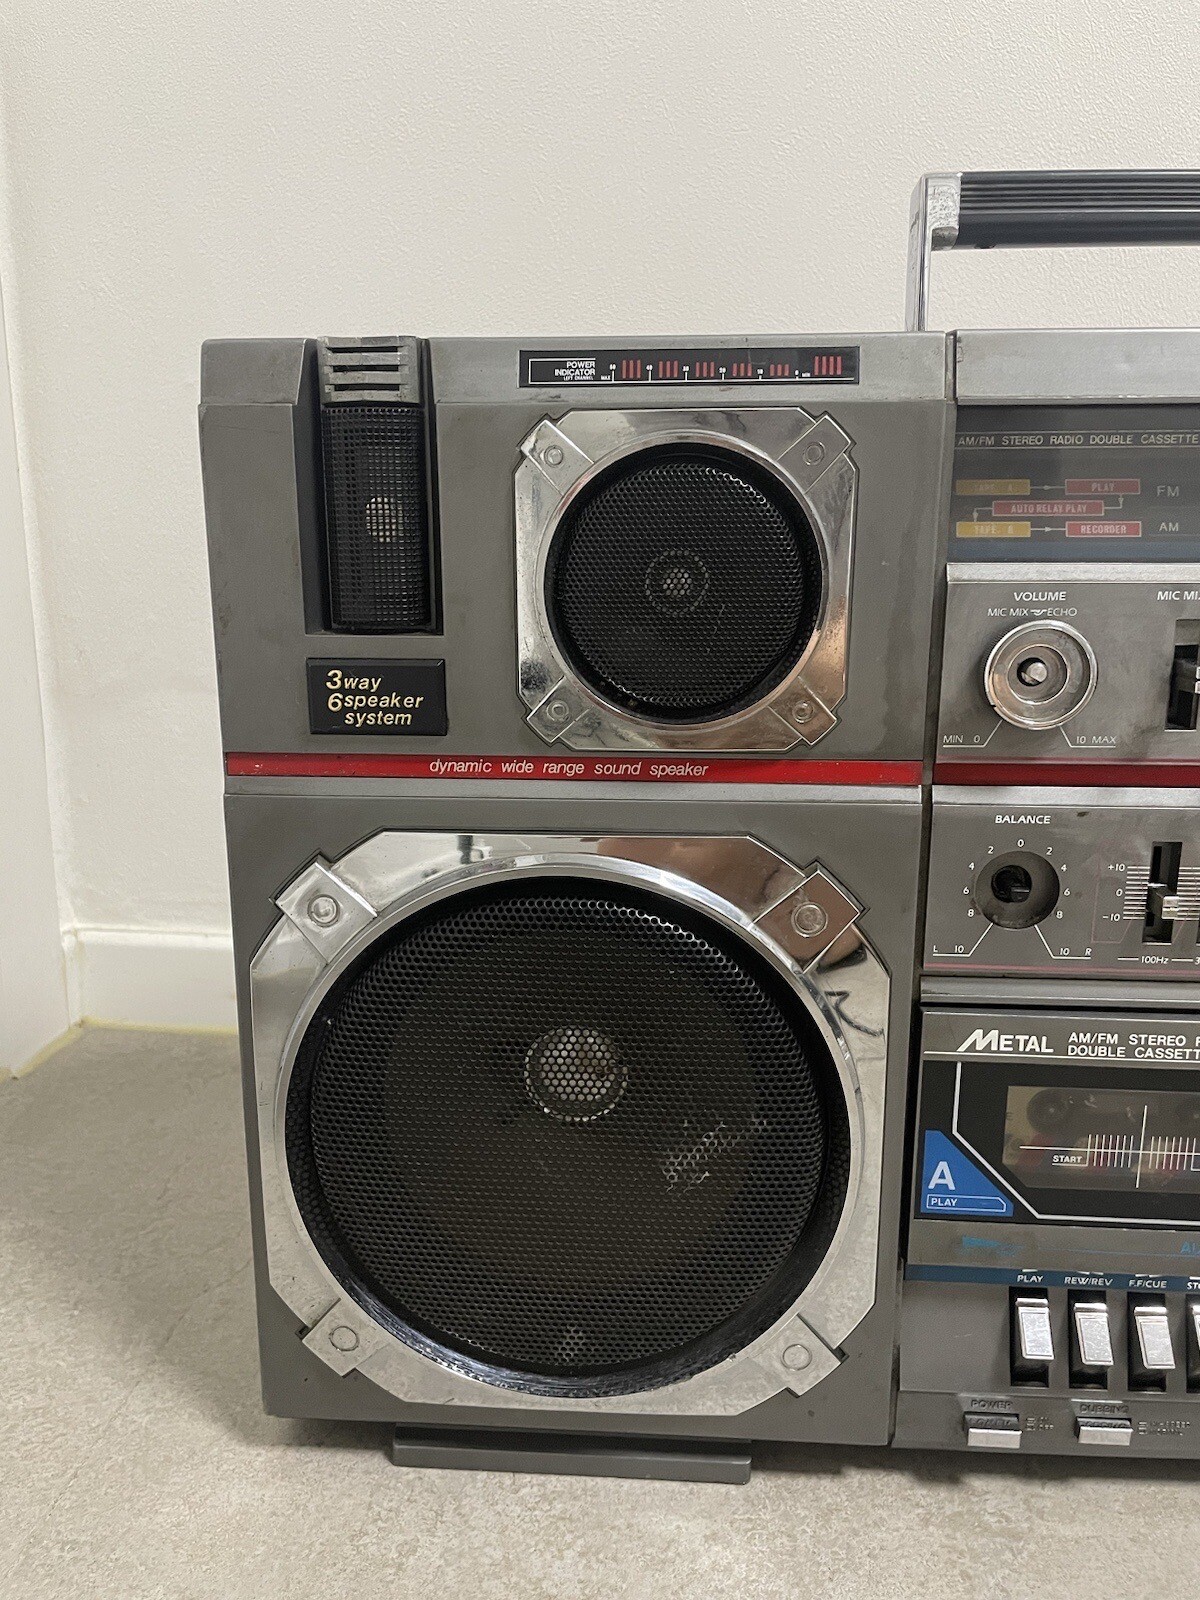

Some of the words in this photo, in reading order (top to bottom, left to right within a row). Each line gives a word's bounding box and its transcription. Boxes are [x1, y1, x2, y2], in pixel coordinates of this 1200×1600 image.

[958, 436, 994, 446] AM/FM
[1002, 436, 1044, 445] STEREO
[1050, 435, 1084, 445] RADIO
[1090, 435, 1132, 445] DOUBLE
[1140, 434, 1199, 444] CASSETTE
[1092, 483, 1114, 492] PLAY
[1156, 486, 1179, 497] FM
[1011, 504, 1035, 514] AUTO
[1036, 504, 1063, 513] RELAY
[1066, 504, 1086, 513] PLAY
[1080, 525, 1126, 534] RECORDER
[1159, 522, 1179, 532] AM
[1014, 591, 1066, 601] VOLUME
[1157, 591, 1180, 600] MIC
[988, 608, 1007, 616] MIC
[1009, 608, 1029, 616] MIX
[1047, 608, 1077, 616] ECHO
[344, 711, 412, 728] system
[974, 735, 980, 743] 0
[1076, 736, 1086, 744] 10
[1092, 736, 1117, 744] MAX
[430, 759, 492, 774] dynamic
[502, 760, 534, 773] wide
[542, 762, 584, 776] range
[594, 762, 641, 775] sound
[650, 763, 709, 778] speaker
[995, 815, 1051, 825] BALANCE
[1017, 839, 1024, 847] 0
[988, 846, 994, 854] 2
[1046, 847, 1053, 855] 2
[1060, 864, 1067, 872] 4
[1063, 888, 1071, 896] 6
[968, 909, 974, 918] 8
[1056, 911, 1063, 919] 8
[1060, 948, 1069, 956] 10
[1142, 956, 1168, 964] 100Hz
[956, 1029, 1054, 1053] METAL
[1068, 1032, 1118, 1045] AM/FM
[1128, 1034, 1186, 1046] STEREO
[1068, 1045, 1125, 1058] DOUBLE
[1052, 1155, 1083, 1163] START
[928, 1161, 955, 1190] A
[931, 1198, 958, 1206] PLAY
[1064, 1277, 1113, 1286] REW/REV
[1187, 1282, 1200, 1290] ST
[971, 1399, 1012, 1410] POWER
[1080, 1404, 1129, 1414] DUBBING
